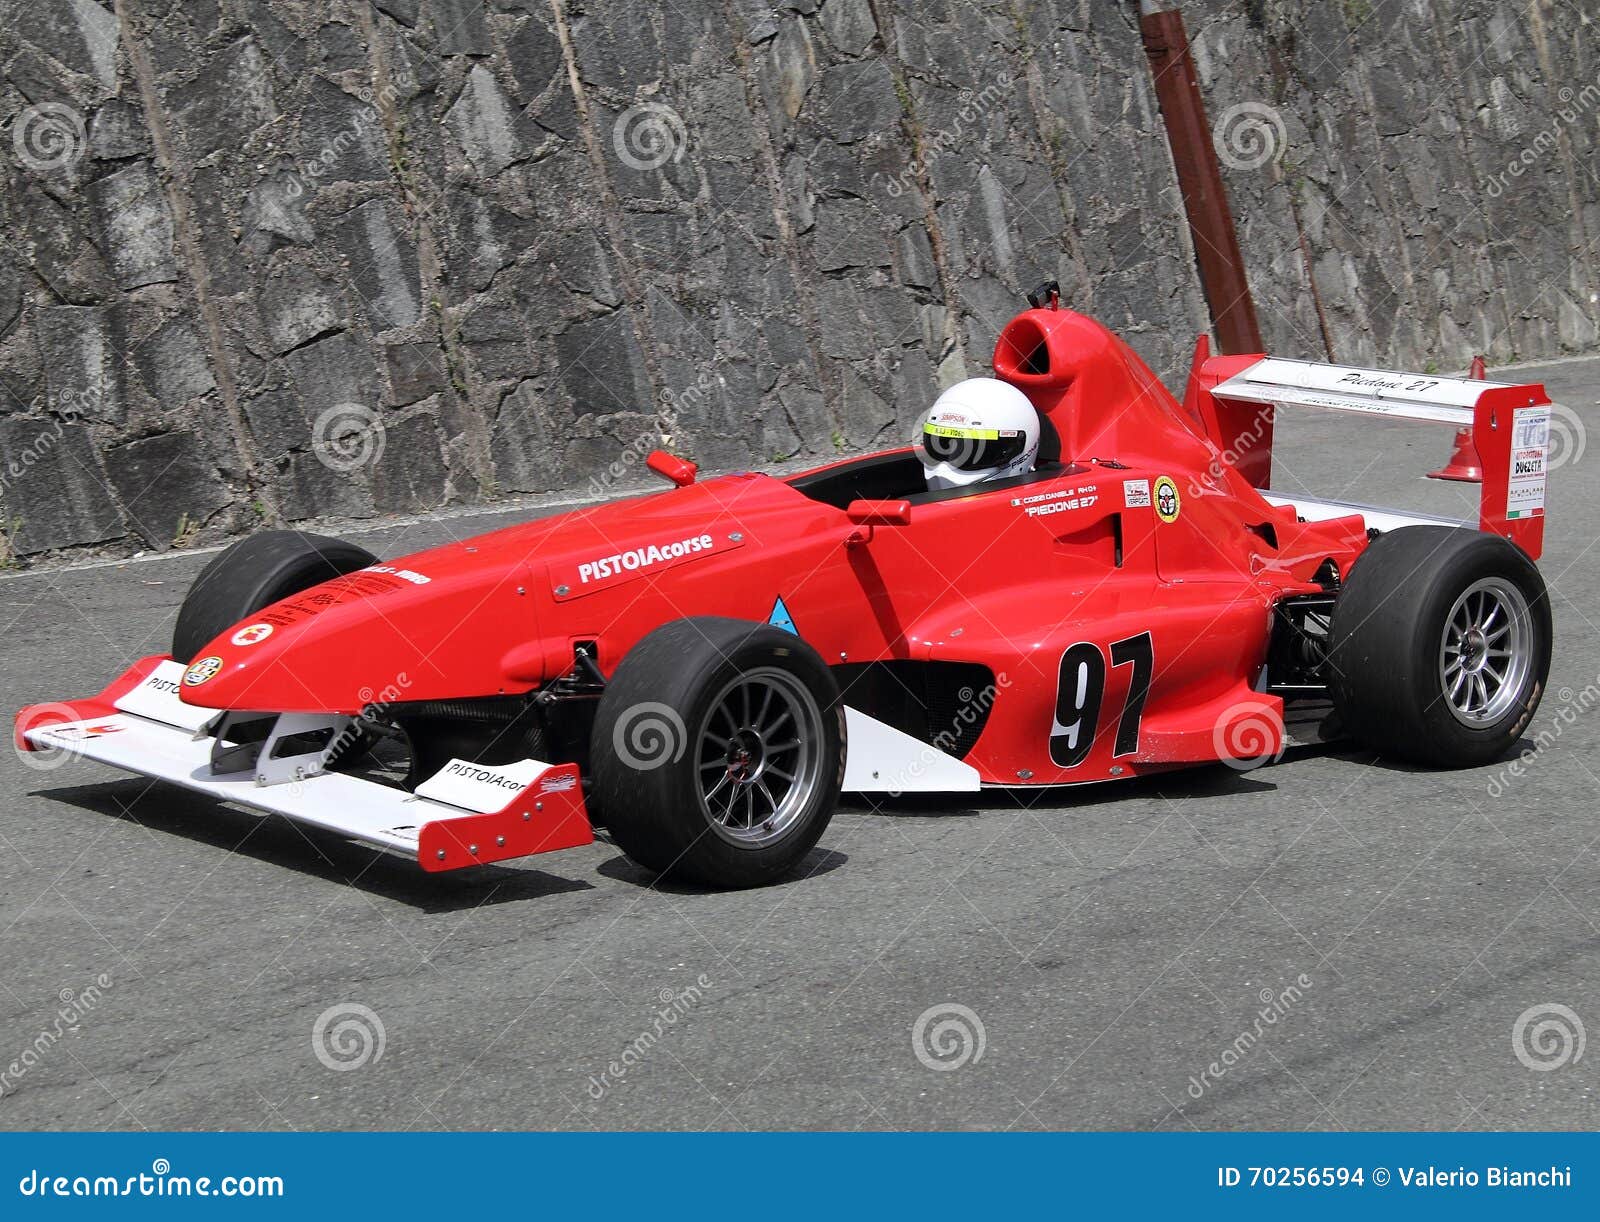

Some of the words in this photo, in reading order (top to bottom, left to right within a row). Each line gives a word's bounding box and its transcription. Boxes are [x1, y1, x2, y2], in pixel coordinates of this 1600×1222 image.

[1336, 373, 1402, 389] Piedone
[1405, 380, 1439, 392] 27
[578, 534, 713, 583] PISTOIAcorse
[1049, 630, 1154, 768] 97
